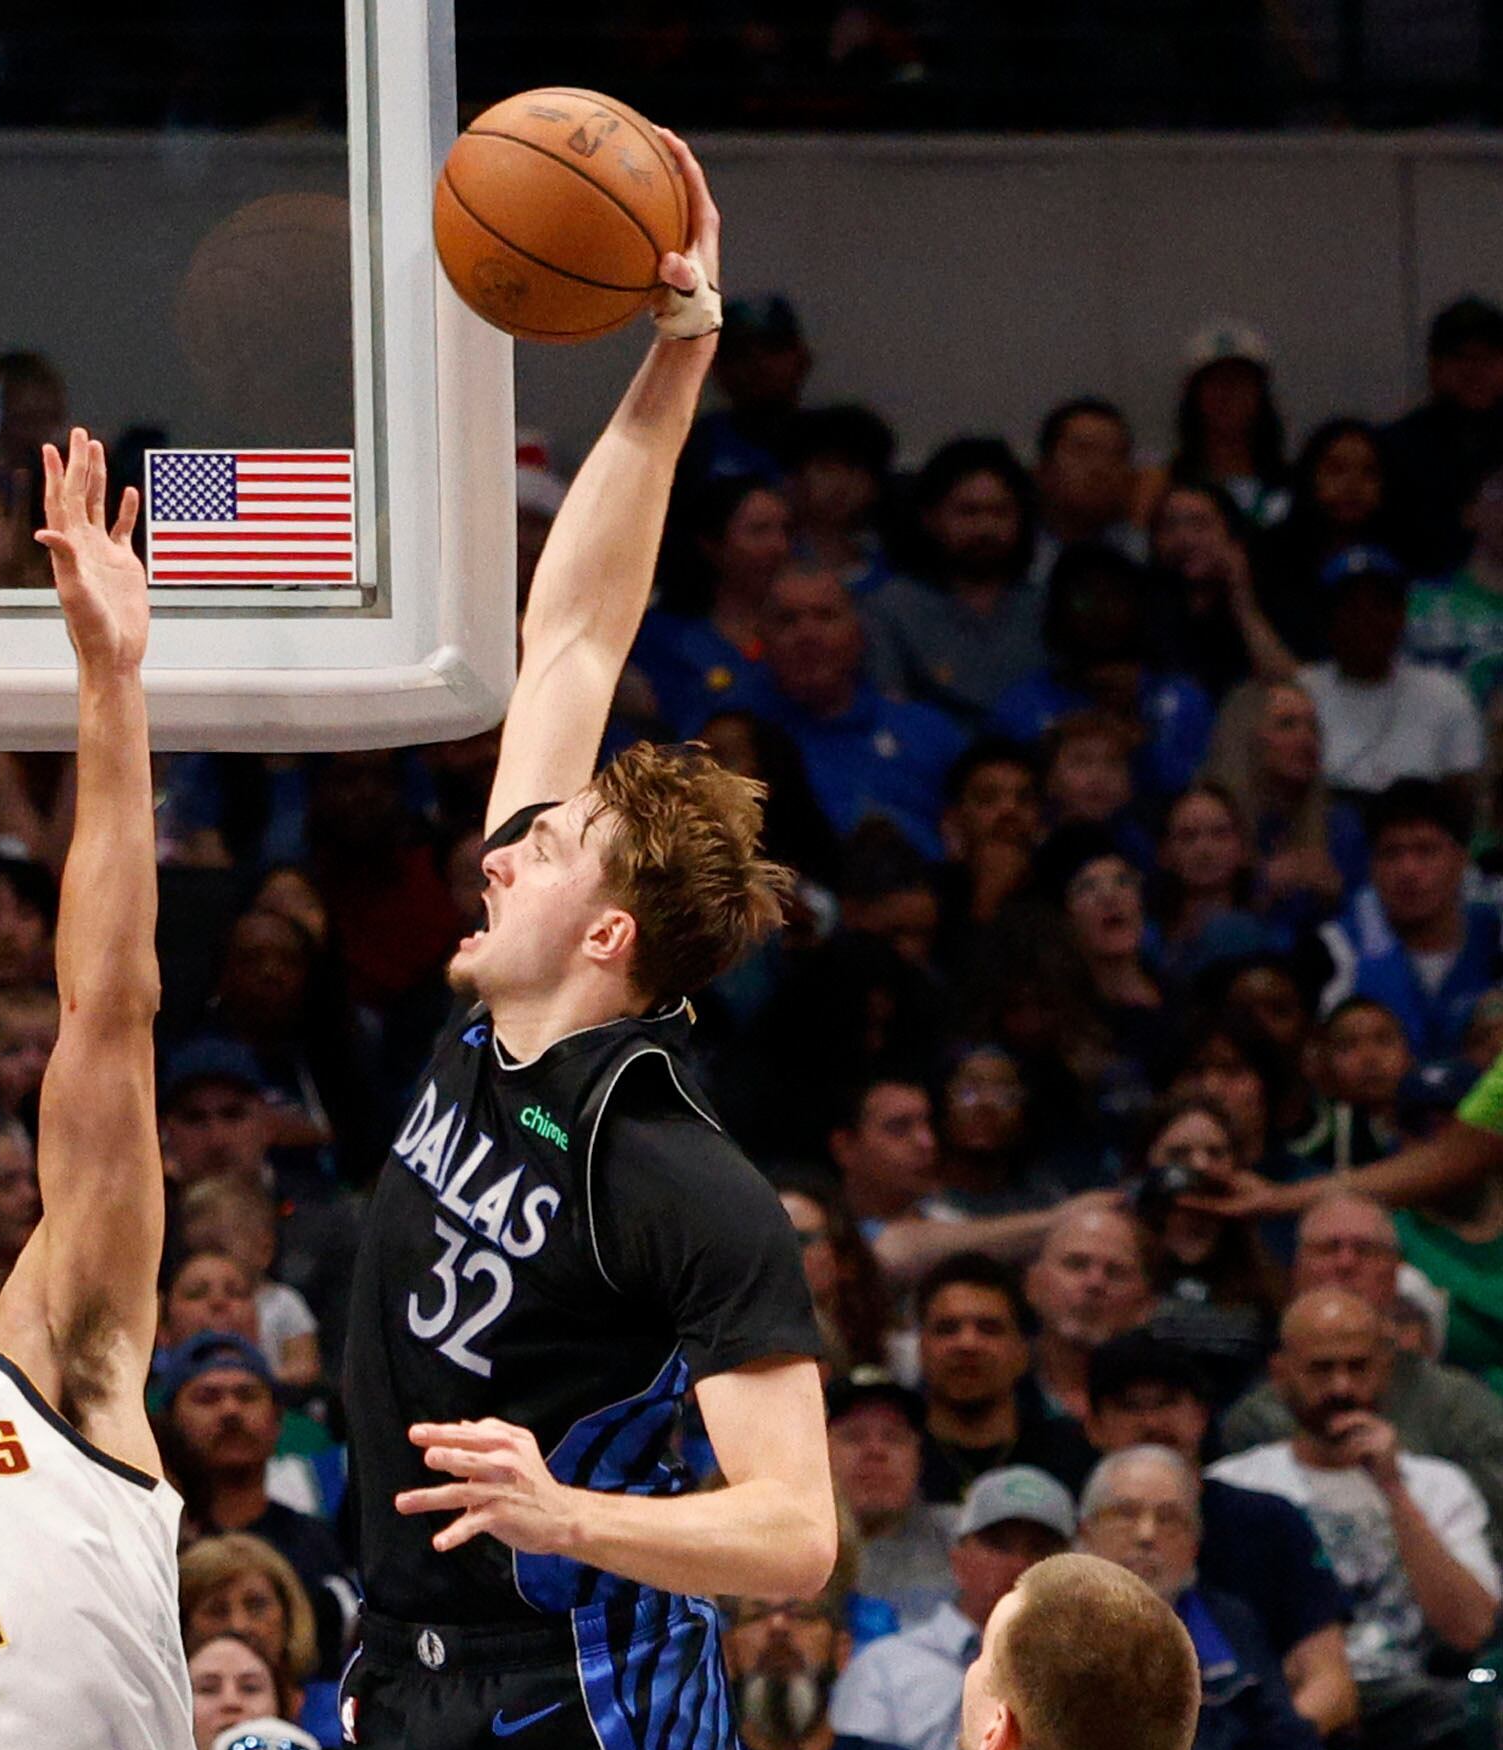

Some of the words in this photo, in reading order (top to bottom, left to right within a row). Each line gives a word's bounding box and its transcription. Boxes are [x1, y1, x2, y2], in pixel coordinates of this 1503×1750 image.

[392, 1079, 562, 1260] DALLAS
[519, 1104, 569, 1152] chime
[407, 1214, 515, 1378] 32
